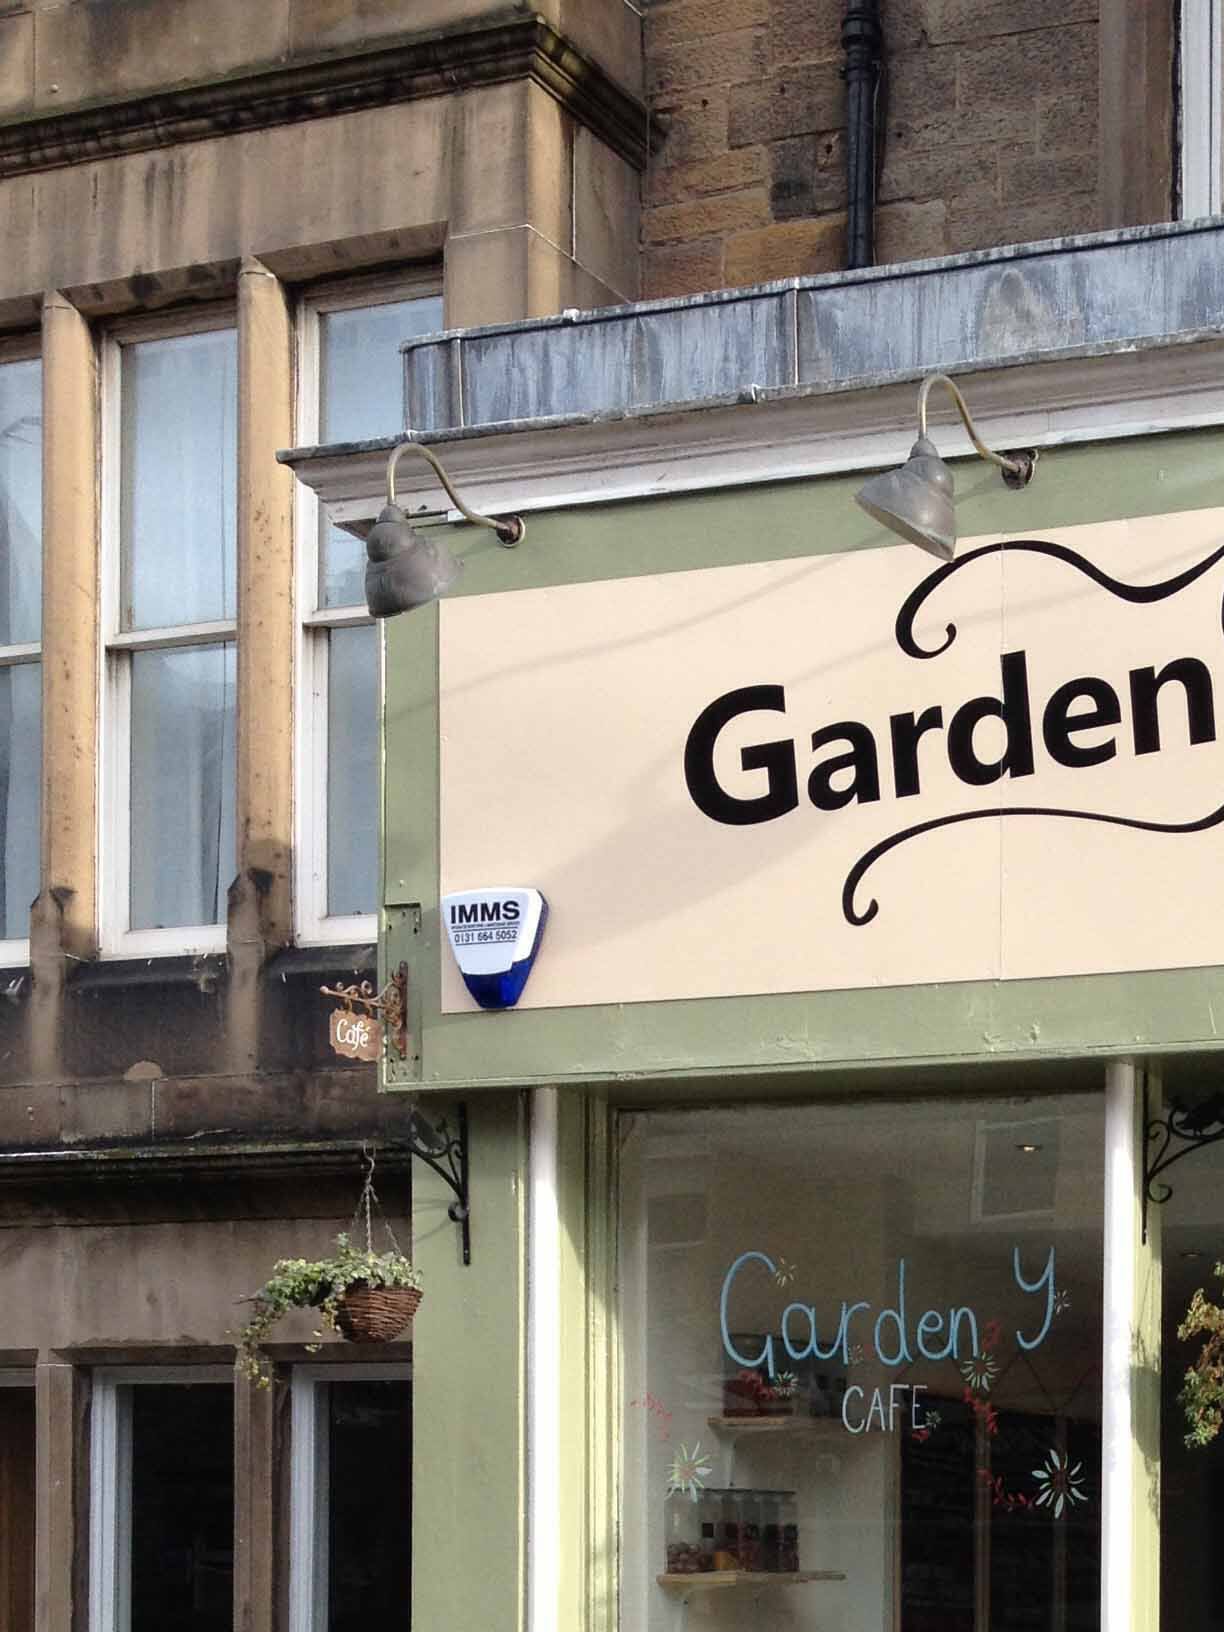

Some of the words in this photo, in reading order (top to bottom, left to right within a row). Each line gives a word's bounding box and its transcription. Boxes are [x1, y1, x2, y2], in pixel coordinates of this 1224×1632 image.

[684, 650, 1217, 827] Garden
[450, 900, 521, 924] IMMS
[454, 932, 475, 943] 0131
[495, 929, 519, 940] 5052
[720, 1250, 979, 1378] Garden
[842, 1384, 929, 1433] CAFE
